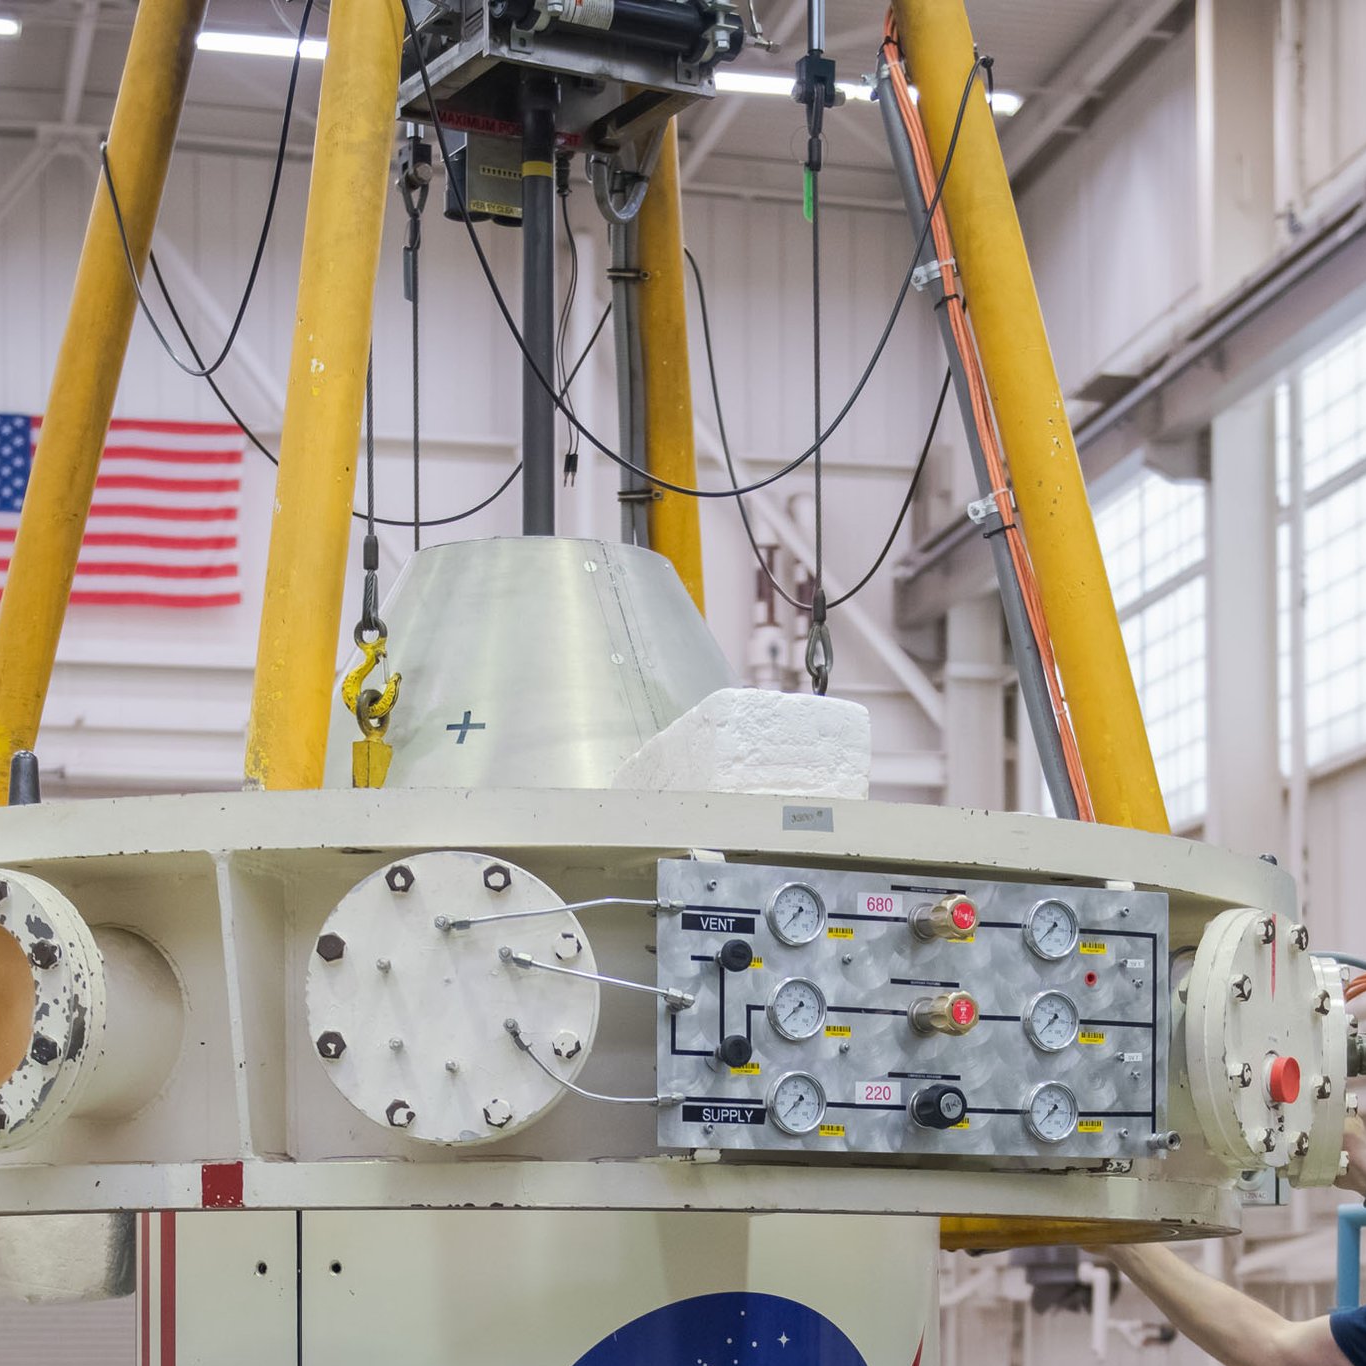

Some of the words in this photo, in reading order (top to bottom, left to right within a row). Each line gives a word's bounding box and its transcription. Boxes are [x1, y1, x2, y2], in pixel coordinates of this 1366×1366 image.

[437, 110, 496, 132] MAXIMUM
[867, 896, 893, 912] 680
[699, 916, 736, 932] VENT
[865, 1085, 892, 1101] 220
[702, 1107, 754, 1123] SUPPLY
